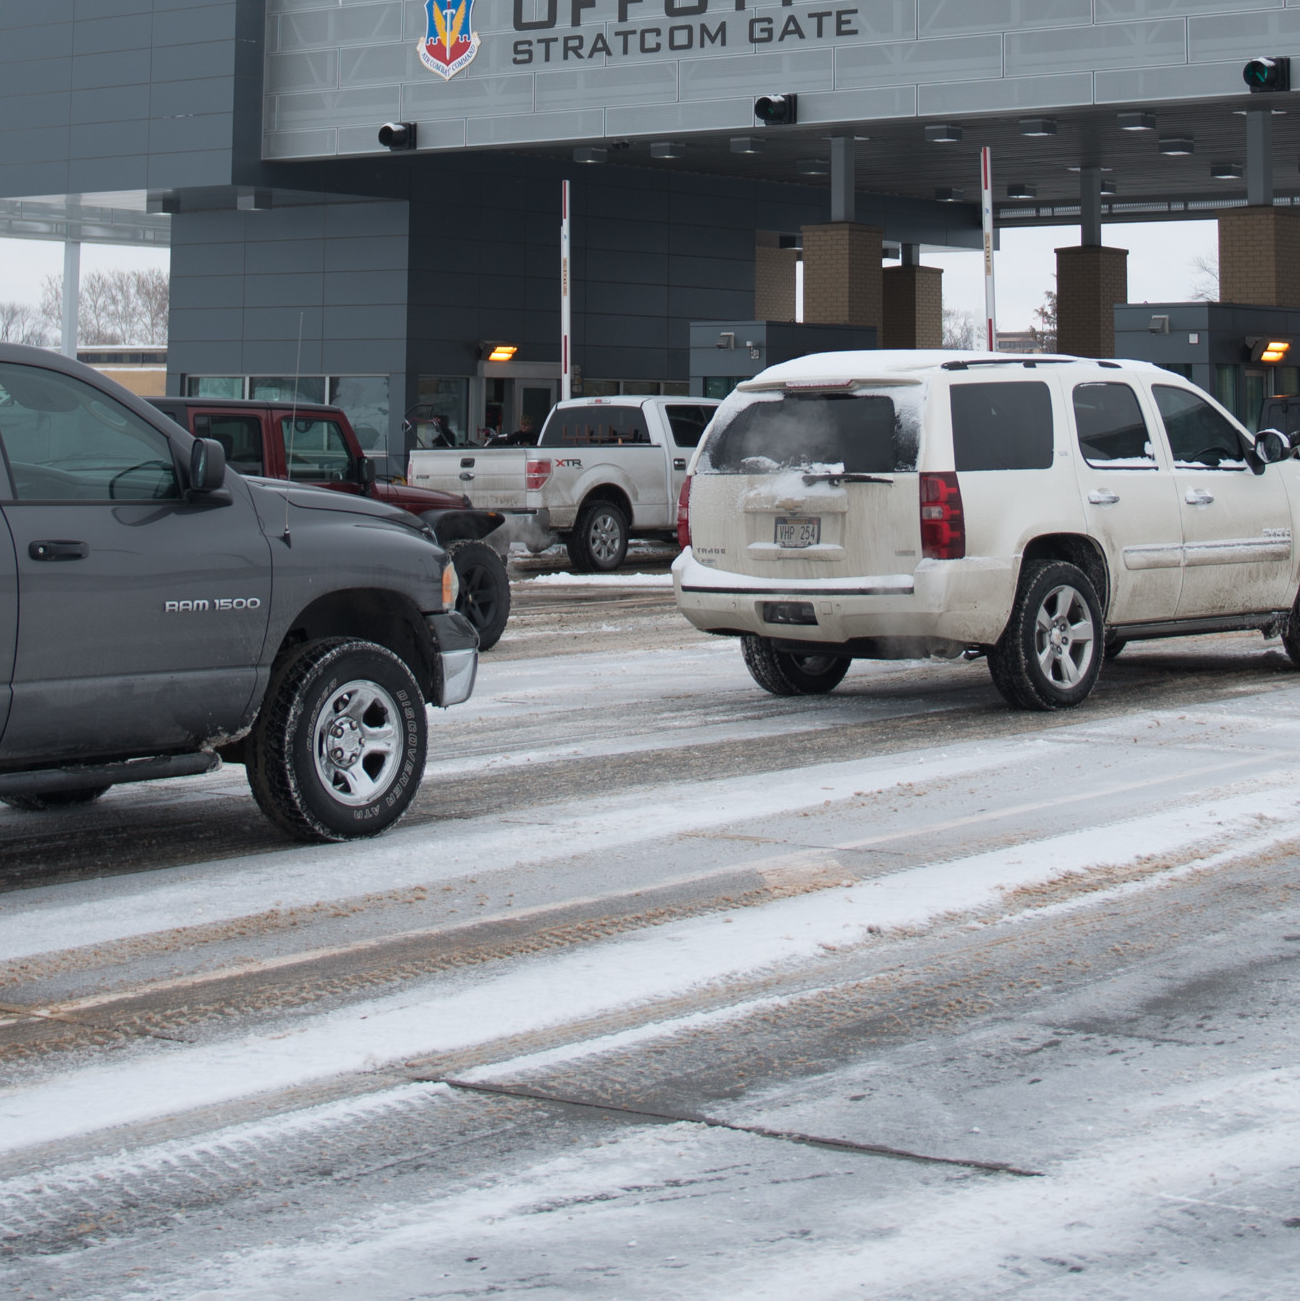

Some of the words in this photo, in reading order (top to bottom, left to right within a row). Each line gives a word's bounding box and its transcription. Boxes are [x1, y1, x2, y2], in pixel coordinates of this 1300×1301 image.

[512, 21, 727, 65] STRATCOM
[748, 8, 859, 46] GATE
[555, 459, 582, 467] XTR
[780, 526, 795, 540] VHP
[800, 525, 815, 540] 254
[164, 600, 209, 612] RAM
[213, 597, 261, 611] 1500
[385, 689, 418, 807] DISCOVERER
